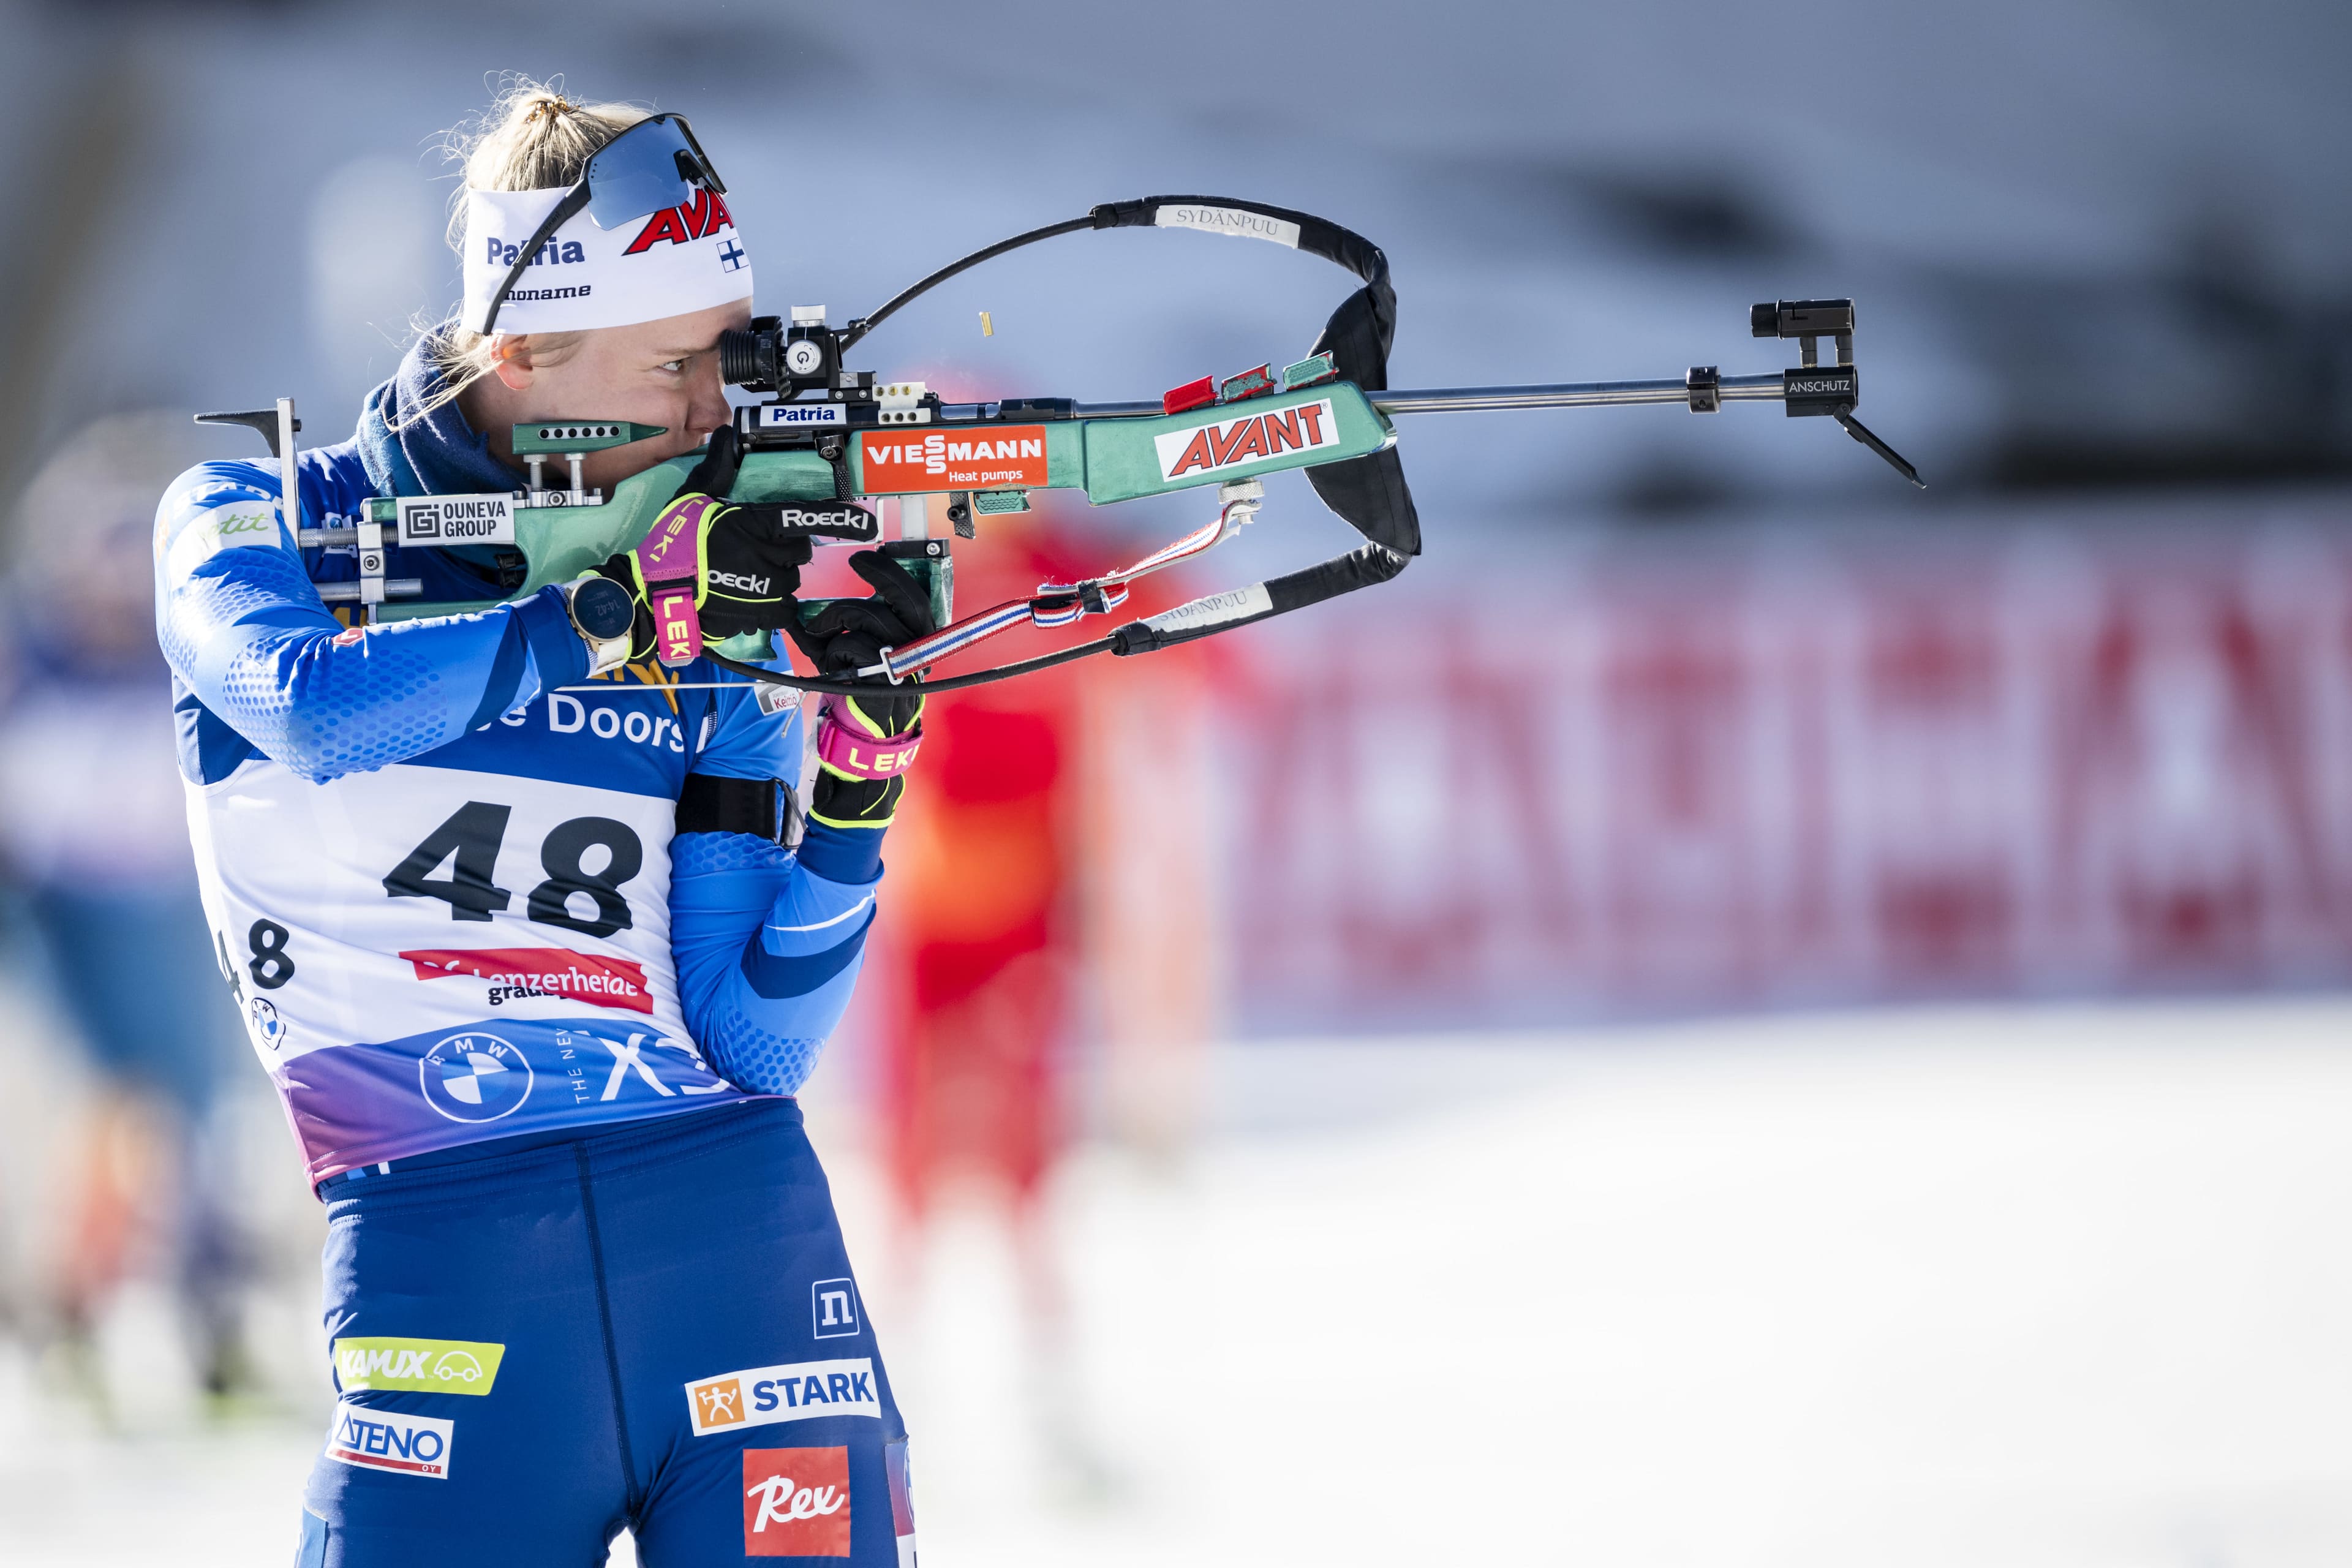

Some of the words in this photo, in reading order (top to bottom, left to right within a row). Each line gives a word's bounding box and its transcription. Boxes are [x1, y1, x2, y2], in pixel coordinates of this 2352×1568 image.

[621, 186, 734, 256] AVA
[1177, 209, 1278, 236] SYDÄNPUU
[505, 285, 591, 301] noname
[773, 407, 835, 421] Patria
[867, 435, 1041, 474] VIESSMANN
[1168, 404, 1323, 478] AVANT
[949, 472, 978, 482] Heat
[981, 470, 1023, 483] pumps
[209, 513, 268, 538] etit
[443, 501, 506, 519] OUNEVA
[445, 520, 496, 537] GROUP
[649, 499, 704, 562] LEKI
[663, 596, 691, 659] LEK
[548, 693, 685, 753] Doors
[848, 744, 919, 772] LEKI
[382, 800, 643, 939] 48
[427, 1038, 508, 1066] BMW
[567, 1068, 590, 1104] THE
[341, 1349, 433, 1379] KAMUX
[753, 1372, 875, 1411] STARK
[336, 1411, 443, 1461] ATENO
[747, 1474, 845, 1533] Rex
